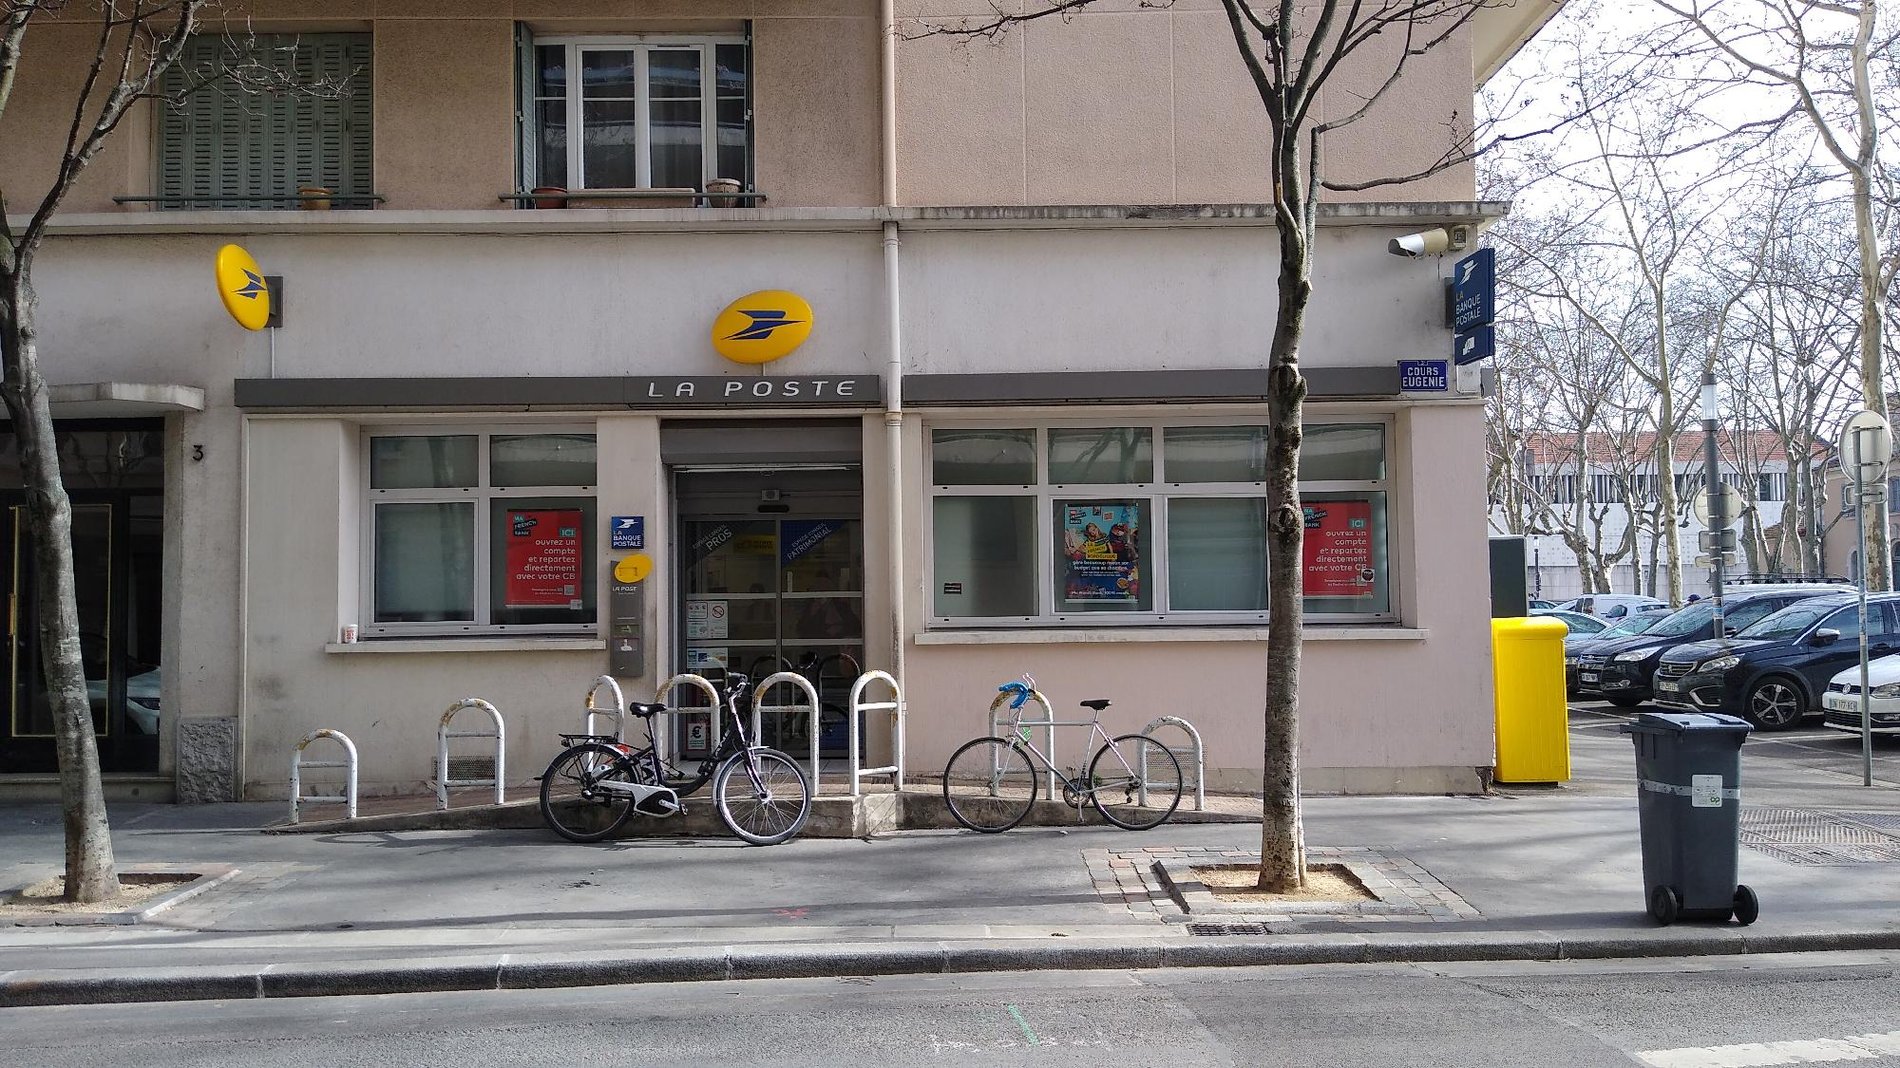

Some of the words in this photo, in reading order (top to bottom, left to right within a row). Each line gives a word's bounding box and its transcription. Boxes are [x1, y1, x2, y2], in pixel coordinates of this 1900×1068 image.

[1456, 290, 1464, 301] LA
[1456, 294, 1480, 315] BANQUE
[1456, 307, 1480, 328] POSTALE
[1407, 367, 1439, 376] COURS
[1402, 376, 1445, 387] EUGENIE
[648, 382, 696, 397] LA
[724, 380, 856, 397] POSTE
[192, 444, 204, 461] 3
[1352, 520, 1364, 528] ICI
[705, 528, 732, 551] PROS
[786, 526, 832, 560] PATRIMONIAL
[1334, 538, 1367, 547] compte
[544, 548, 576, 556] compte
[1330, 547, 1367, 556] repartez
[540, 556, 576, 564] repartez
[1316, 555, 1368, 563] directement
[524, 564, 576, 572] directement
[1330, 564, 1352, 572] votre
[538, 572, 560, 580] votre
[562, 572, 576, 580] CB
